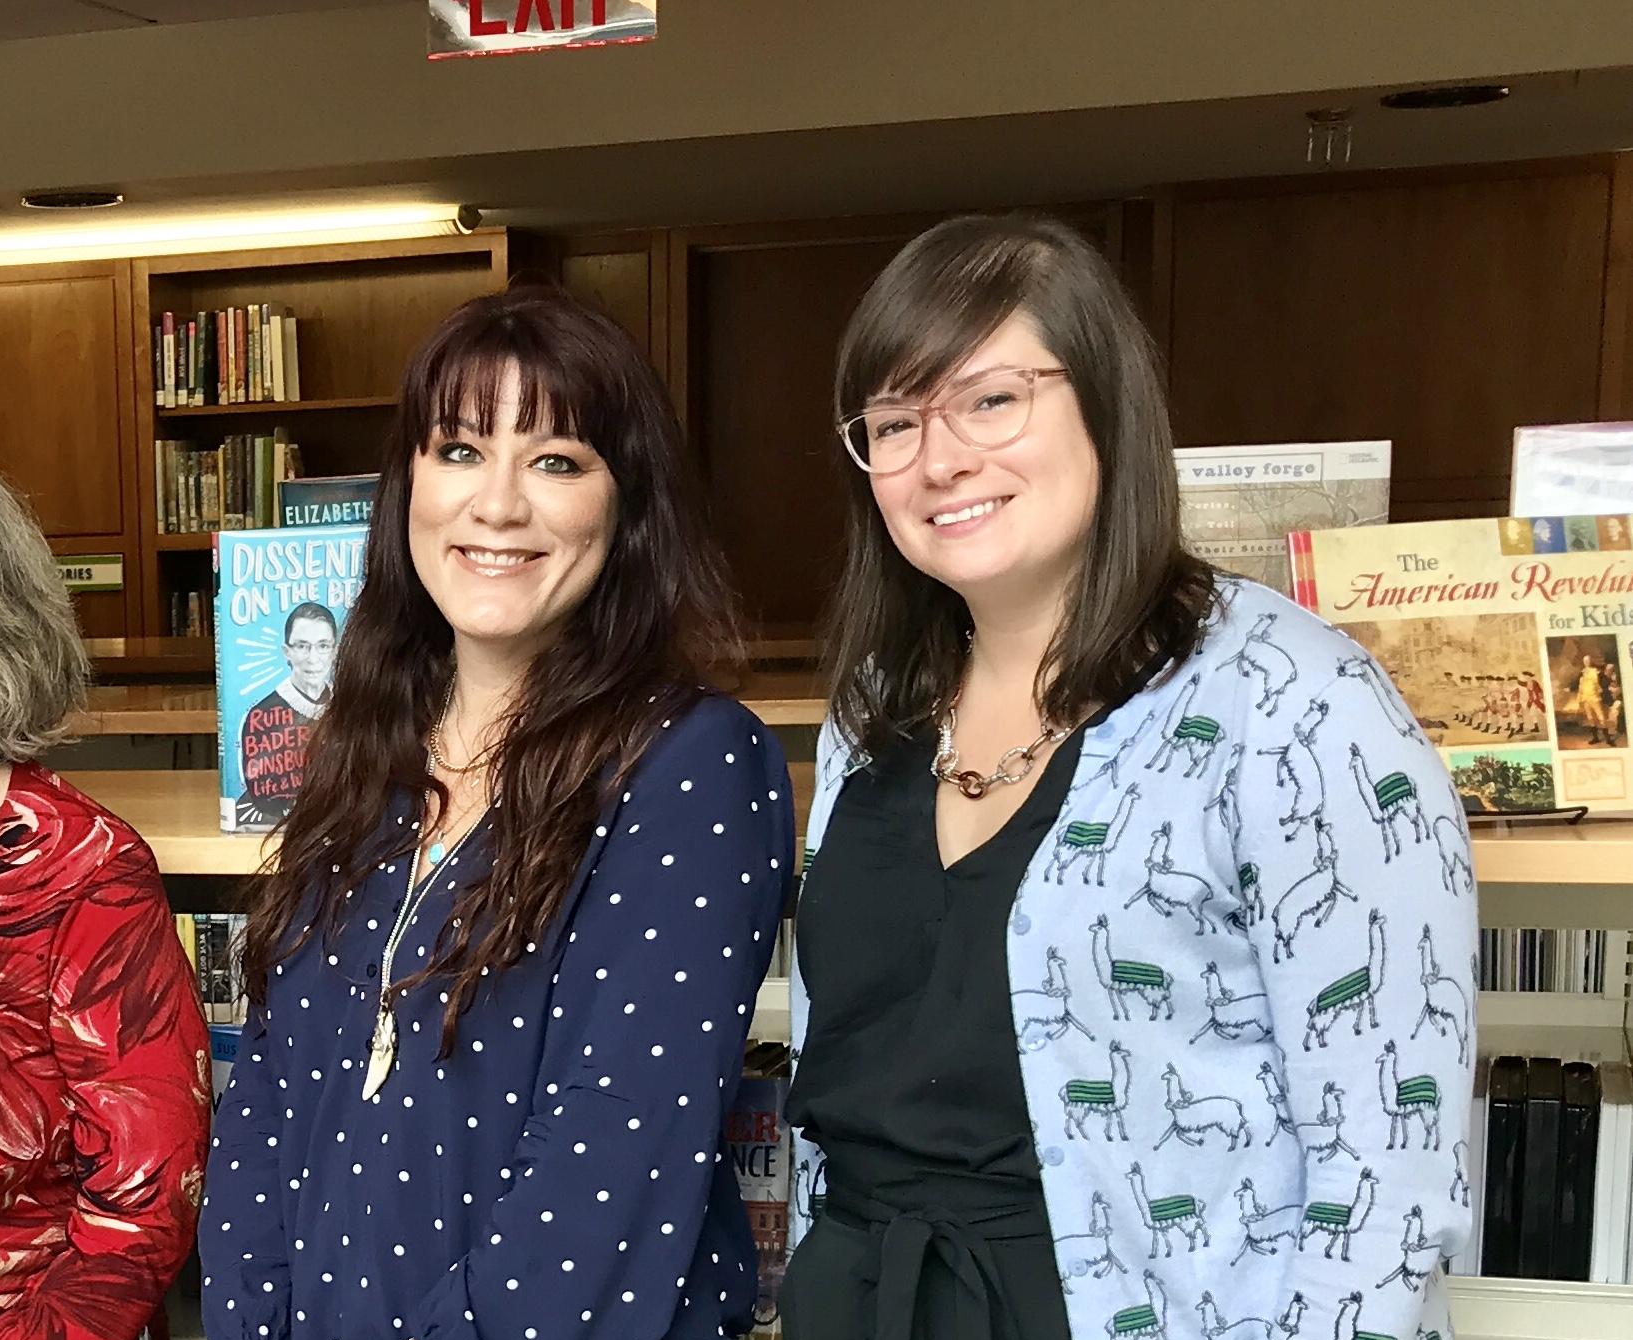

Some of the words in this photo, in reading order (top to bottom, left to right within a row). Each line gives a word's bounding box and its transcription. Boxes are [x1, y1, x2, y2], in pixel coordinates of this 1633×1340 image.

[1192, 464, 1255, 479] valley
[1263, 463, 1316, 478] forge
[285, 501, 373, 525] ELIZABETH
[1241, 545, 1287, 553] Storie
[232, 538, 366, 586] DISSENT
[1397, 554, 1439, 572] The
[230, 585, 271, 626] ON
[274, 579, 321, 613] THE
[327, 578, 364, 610] BE
[1334, 572, 1500, 611] American
[1549, 613, 1575, 630] for
[250, 706, 294, 733] RUTH
[245, 726, 310, 757] BADER
[247, 750, 305, 780] GINSBU
[254, 778, 277, 797] Life
